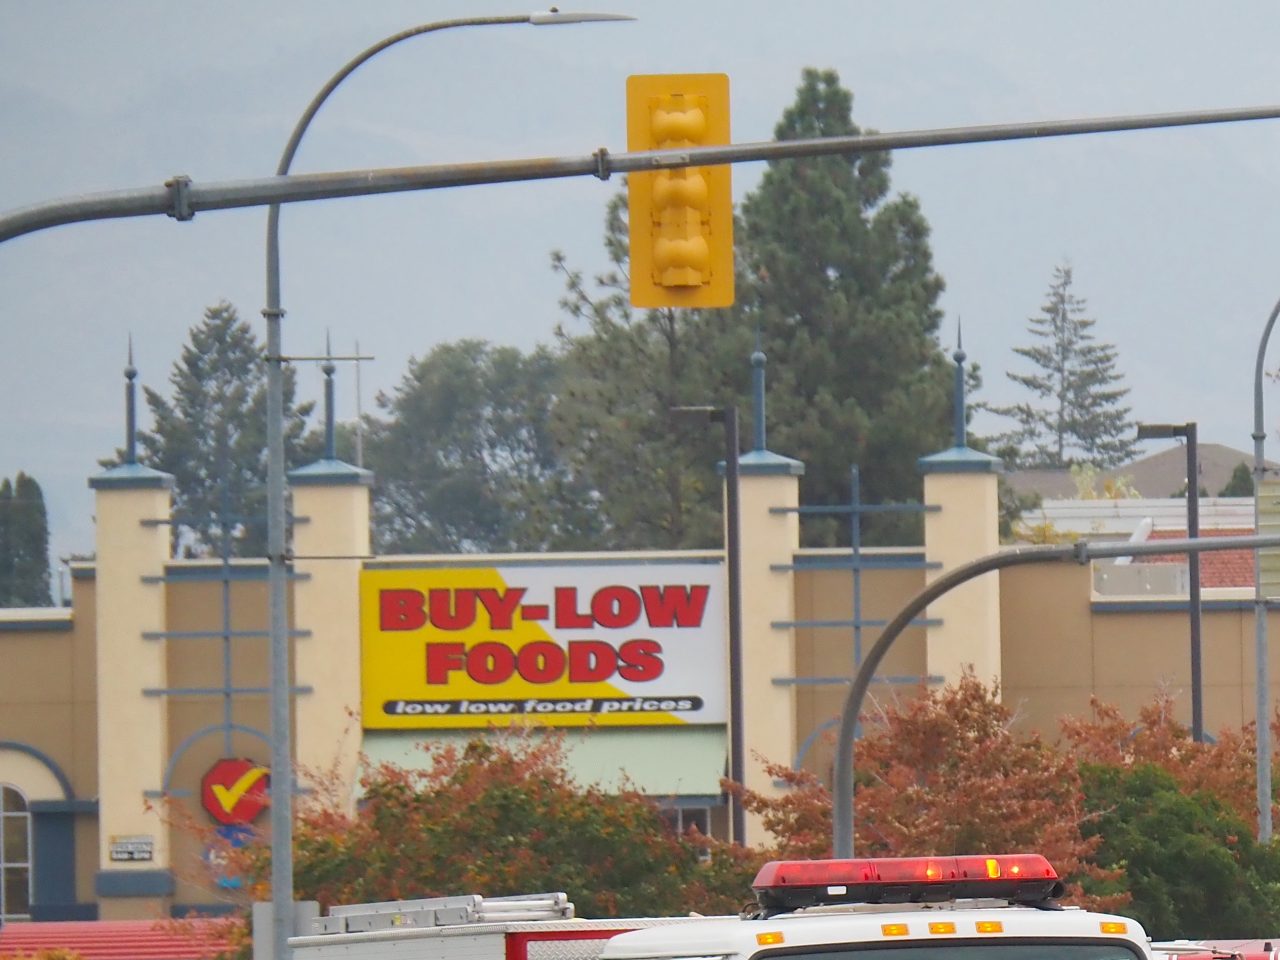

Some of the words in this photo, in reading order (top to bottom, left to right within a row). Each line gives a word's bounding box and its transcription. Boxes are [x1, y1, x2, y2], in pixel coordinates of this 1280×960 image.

[379, 584, 711, 632] BUY-LOW
[426, 638, 665, 684] FOODS
[395, 701, 450, 714] low
[460, 700, 515, 713] low
[524, 699, 594, 713] food
[601, 698, 693, 713] prices
